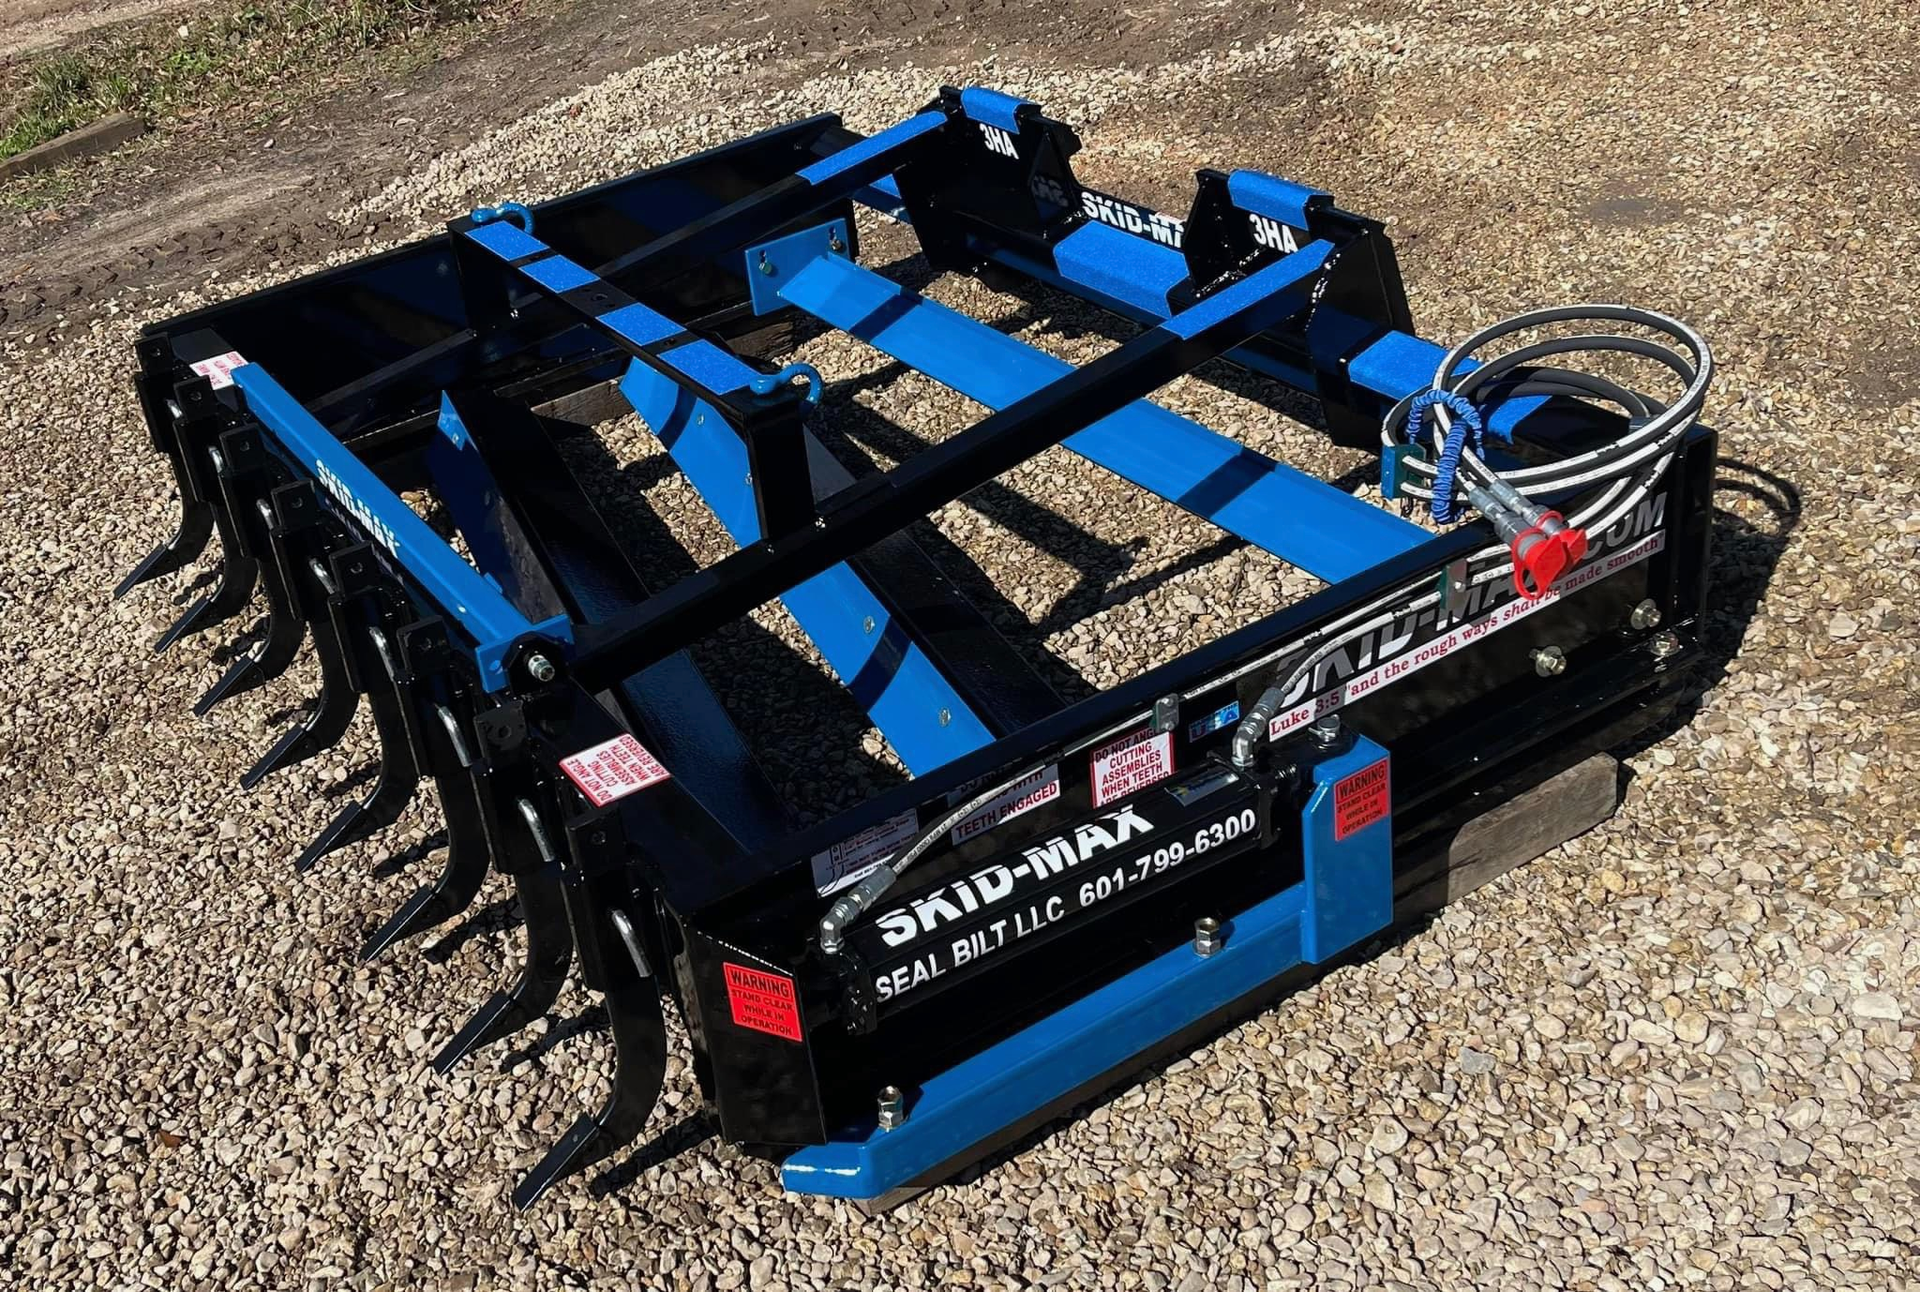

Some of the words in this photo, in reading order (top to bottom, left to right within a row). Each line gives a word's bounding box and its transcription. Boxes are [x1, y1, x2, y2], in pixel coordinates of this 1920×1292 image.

[979, 122, 1020, 160] 3HA
[1249, 213, 1298, 254] 3HA
[315, 459, 400, 559] SKID-MAX
[1270, 707, 1310, 736] Luke
[1314, 690, 1340, 714] 3:5
[1384, 658, 1410, 679] the
[1414, 635, 1458, 665] rough
[1462, 615, 1499, 641] ways
[1565, 564, 1603, 591] made
[608, 744, 634, 765] TEETH
[1095, 749, 1110, 764] DO
[1112, 739, 1132, 756] NOT
[1133, 727, 1158, 747] ANG
[1109, 741, 1152, 769] CUTTING
[567, 758, 591, 779] ANGLE
[587, 760, 619, 788] CUTTING
[596, 750, 636, 786] ASSEMBLIES
[627, 762, 651, 782] WHEN
[646, 763, 668, 777] ARE
[1101, 777, 1131, 798] WHEN
[1132, 761, 1163, 783] TEETH
[1102, 749, 1162, 786] ASSEMBLIES
[1340, 764, 1385, 799] WARNING
[584, 779, 605, 792] NOT
[597, 790, 613, 802] DO
[955, 810, 997, 839] TEETH
[999, 782, 1058, 818] ENGAGED
[875, 803, 1155, 948] SKID-MAX
[875, 953, 947, 1003] SEAL
[952, 919, 1008, 968] BILT
[1015, 895, 1065, 938] LLC
[1079, 808, 1257, 907] 601-799-6300
[730, 969, 789, 998] WARNING
[731, 990, 761, 1004] STAND
[763, 997, 793, 1012] CLEAR
[744, 1004, 772, 1018] WHILE
[774, 1012, 785, 1022] IN
[741, 1014, 792, 1036] OPERATION
